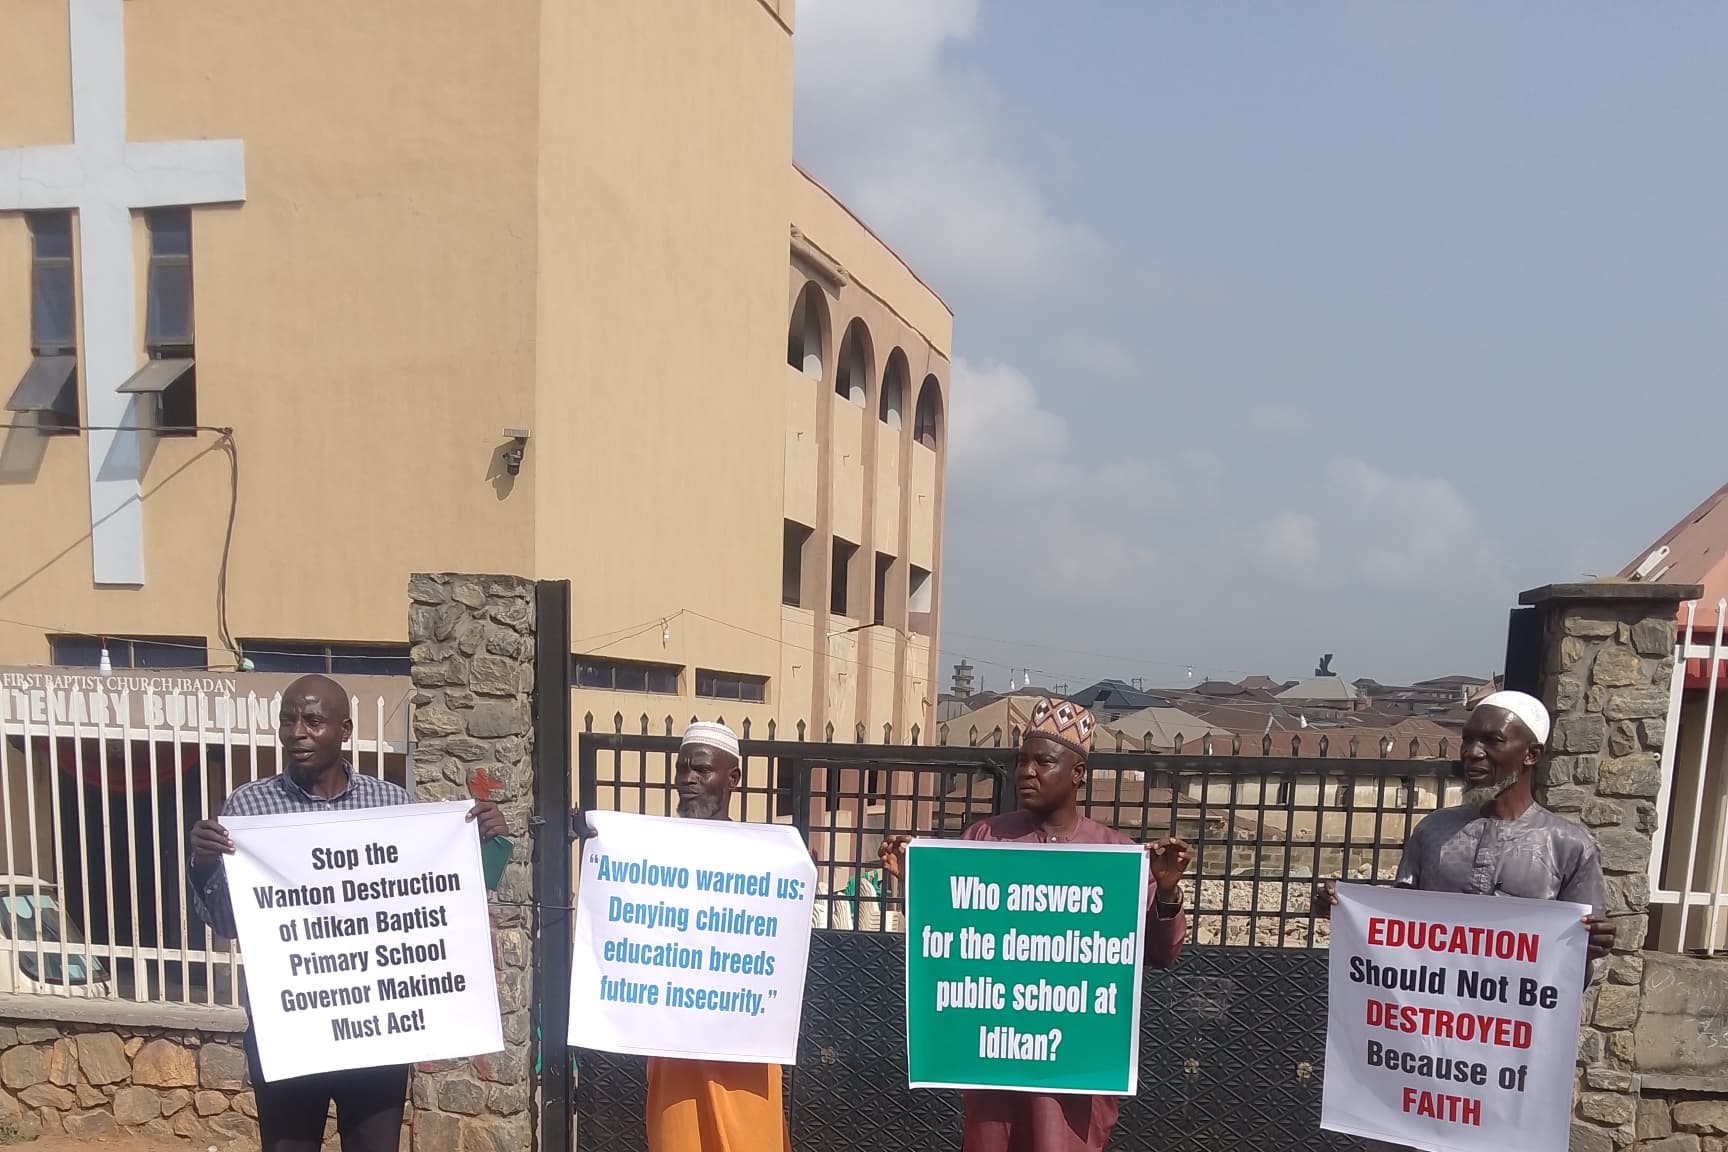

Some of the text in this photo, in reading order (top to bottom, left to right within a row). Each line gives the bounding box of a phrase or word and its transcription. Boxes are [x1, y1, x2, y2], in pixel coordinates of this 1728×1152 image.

[3, 672, 236, 693] FIRST BAPTIST CHURCH IBADAN
[312, 842, 398, 870] Stop the
[253, 873, 460, 910] Wanton Destruction
[696, 869, 770, 897] warned
[777, 877, 805, 900] us:
[950, 876, 1104, 913] Who answers
[278, 906, 448, 942] of Idikan Baptist
[608, 896, 777, 937] Denying children
[290, 938, 446, 976] Primary School
[604, 938, 775, 976] education breeds
[922, 925, 1135, 965] for the demolished
[1368, 918, 1539, 962] EDUCATION
[281, 972, 466, 1012] Governor Makinde
[600, 975, 659, 1005] future
[936, 976, 1117, 1014] public school at
[1350, 956, 1558, 1009] Should Not Be
[332, 1009, 426, 1041] Must Act!
[1367, 999, 1532, 1049] DESTROYED
[979, 1026, 1062, 1061] Idikan?
[1368, 1040, 1528, 1092] Because of
[1402, 1088, 1481, 1126] FAITH
